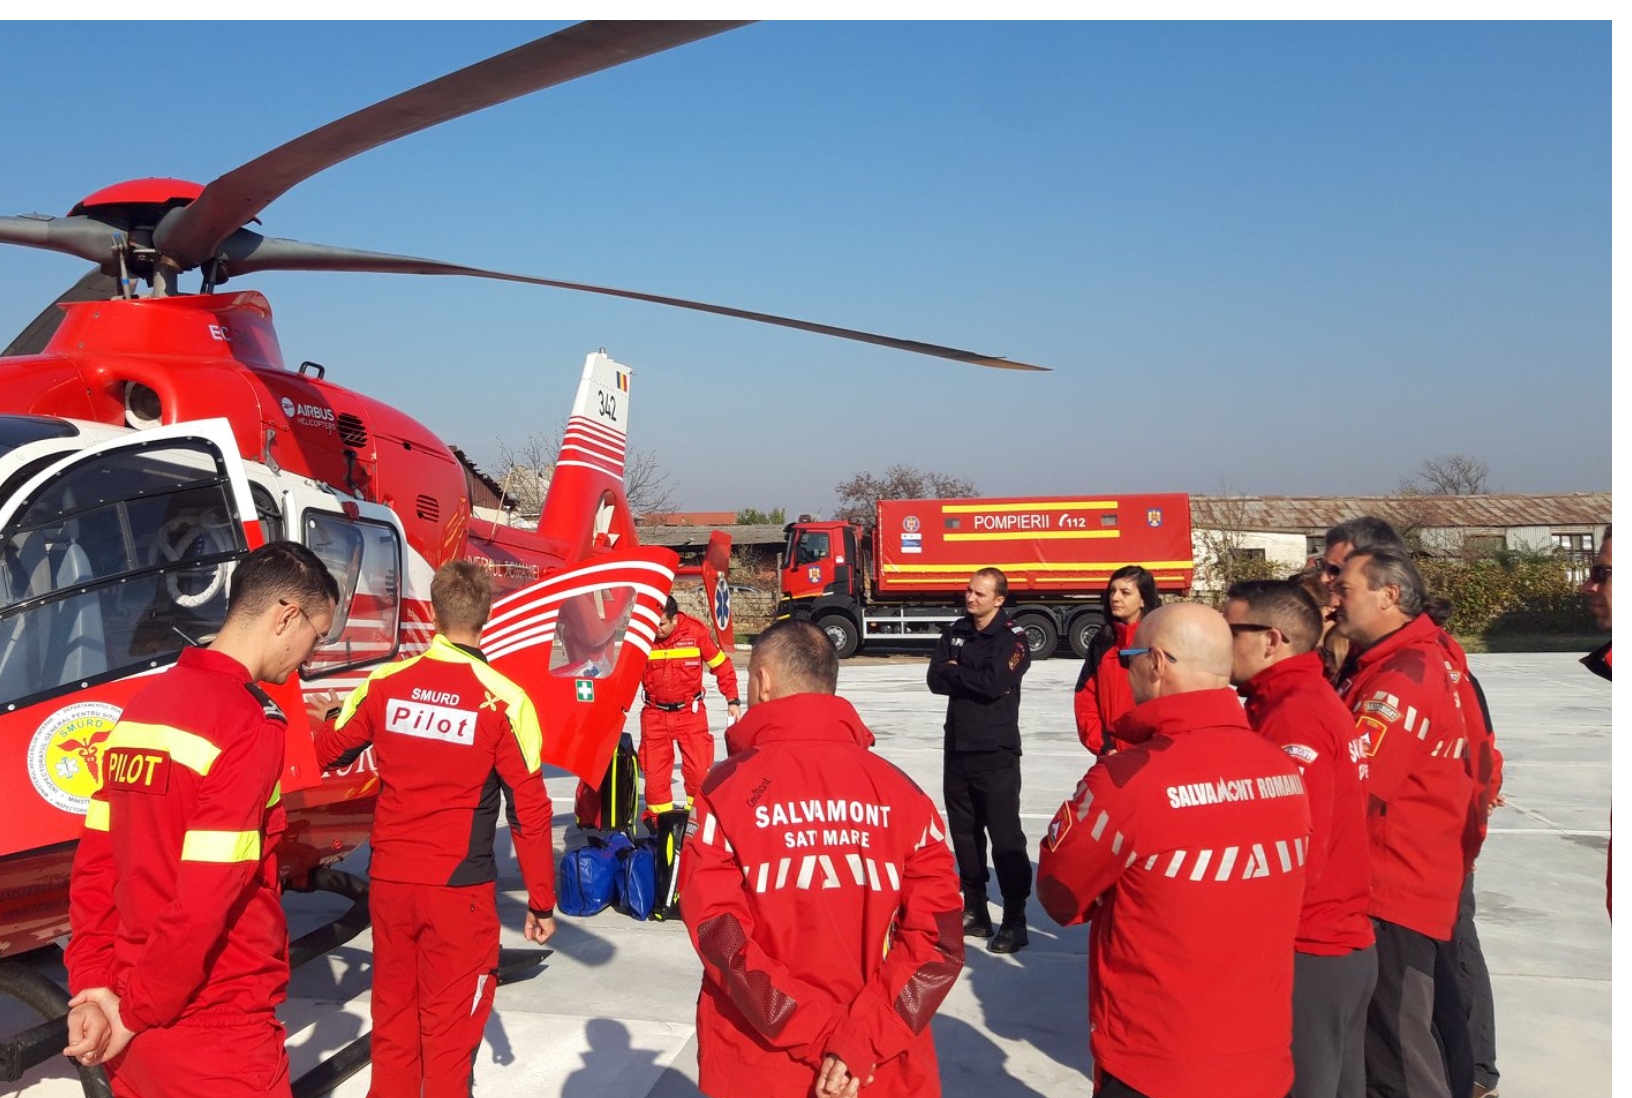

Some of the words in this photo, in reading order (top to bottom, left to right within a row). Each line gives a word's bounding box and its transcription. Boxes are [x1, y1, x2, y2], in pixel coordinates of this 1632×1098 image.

[297, 403, 335, 422] AIRBUS
[598, 389, 617, 422] 342
[297, 417, 337, 432] HELICOPTERS
[974, 514, 1050, 530] POMPIERII
[1067, 517, 1086, 528] 112
[411, 688, 460, 706] SMURD
[59, 719, 103, 738] SMURD
[392, 707, 467, 737] Pilot
[109, 752, 163, 786] PILOT
[1167, 776, 1255, 809] SALVAMONT
[755, 799, 891, 829] SALVAMONT
[784, 830, 818, 848] SAT
[823, 830, 870, 848] MARE
